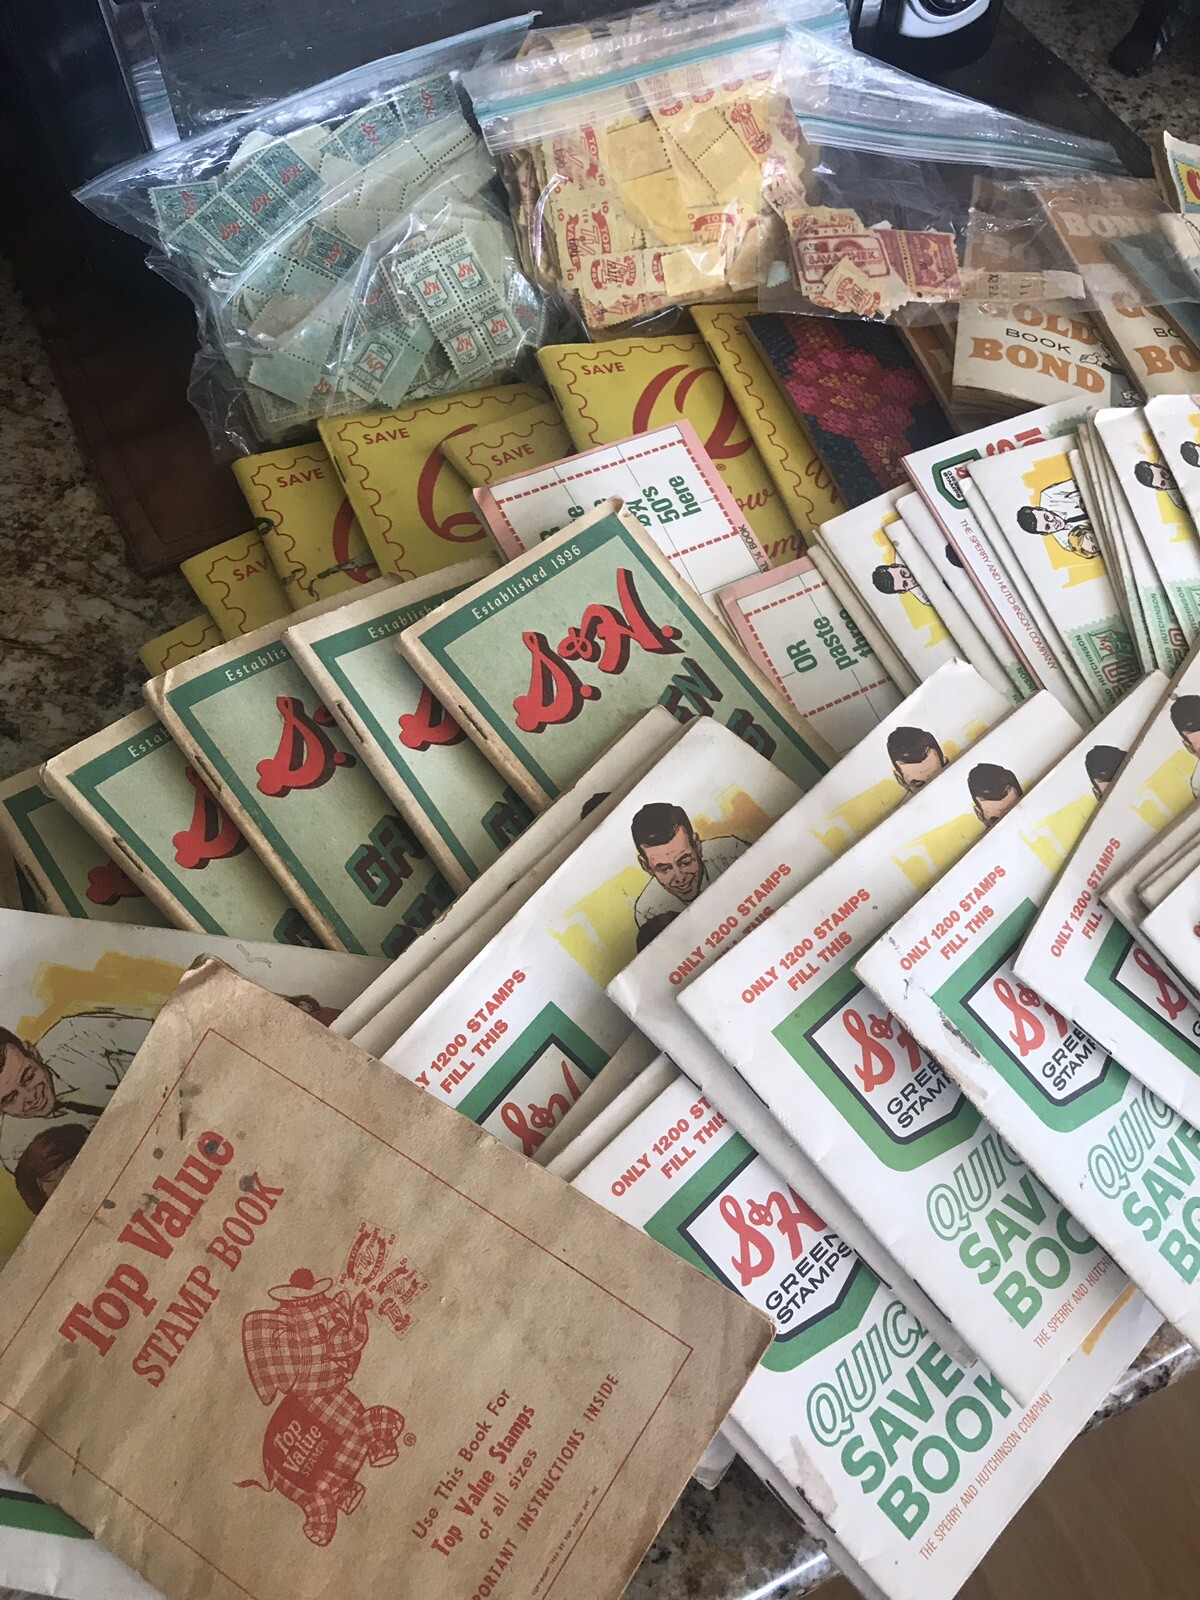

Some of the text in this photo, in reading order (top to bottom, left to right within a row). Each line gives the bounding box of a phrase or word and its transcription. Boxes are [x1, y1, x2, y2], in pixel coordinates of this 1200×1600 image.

[581, 362, 626, 376] SAVE
[969, 337, 1105, 393] BOND
[1006, 328, 1071, 354] BOOK
[362, 427, 410, 445] SAVE
[491, 444, 535, 466] SAVE
[276, 467, 325, 488] SAVE
[668, 475, 702, 518] here
[233, 557, 269, 581] SAV
[739, 524, 758, 550] BOOK
[471, 543, 581, 621] Established 1896
[960, 518, 1058, 670] THE SPERRY AND HUTCHINSON COMPANY
[225, 650, 287, 681] Establis
[786, 639, 818, 673] OR
[813, 616, 858, 670] paste
[1075, 634, 1106, 686] HUTCHINSON
[668, 946, 706, 986] ONLY
[705, 916, 738, 948] 1200
[737, 864, 791, 916] STAMPS
[899, 865, 1006, 972] ONLY 1200 STAMPS
[1050, 920, 1075, 958] ONLY
[1070, 890, 1092, 921] 1200
[1086, 837, 1121, 890] STAMPS
[1081, 909, 1104, 940] FILL
[741, 966, 780, 1003] ONLY
[779, 938, 814, 971] 1200
[813, 888, 871, 940] STAMPS
[787, 931, 853, 992] FILL THIS
[940, 904, 995, 961] FILL THIS
[430, 968, 527, 1076] 1200 STAMPS
[1042, 1028, 1086, 1078] GREE
[439, 1018, 509, 1094] FILL THIS
[887, 1060, 941, 1114] GREE
[610, 1117, 690, 1197] ONLY 1200
[660, 1146, 697, 1180] FILL
[1087, 1084, 1178, 1200] QUIC
[58, 1130, 235, 1357] Top Value
[958, 1170, 1060, 1285] SAV
[132, 1171, 285, 1388] STAMP BOOK
[776, 1242, 853, 1325] STAMPS
[1033, 1330, 1052, 1348] THE
[1047, 1301, 1075, 1331] SPERRY
[1072, 1284, 1089, 1305] AND
[806, 1300, 929, 1448] QUIC
[274, 1420, 301, 1455] Top
[840, 1341, 965, 1494] SAVE
[301, 1438, 329, 1476] STAMPS
[411, 1389, 510, 1539] Use This Book For
[431, 1405, 535, 1557] Top Value Stamps
[517, 1428, 585, 1531] INSTRUCTIONS
[583, 1374, 619, 1422] INSIDE
[918, 1388, 1053, 1560] THE SPERRY AND HUTCHINSON COMPANY
[479, 1449, 537, 1540] of all sizes
